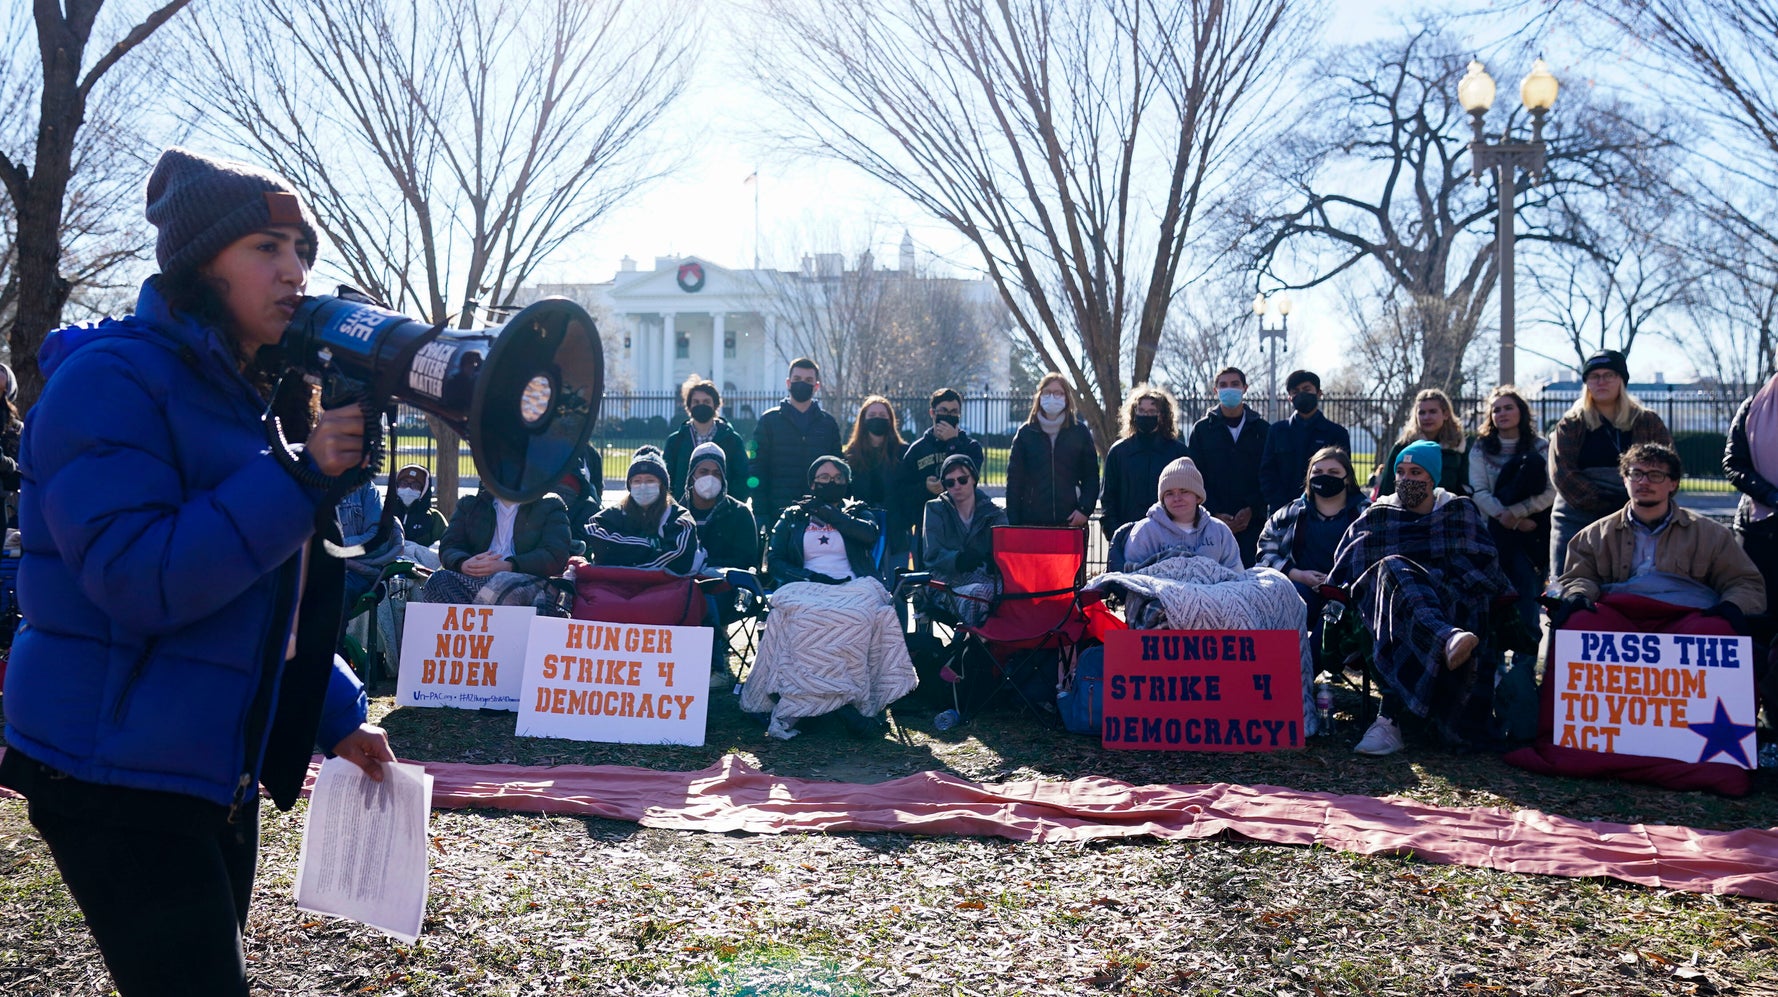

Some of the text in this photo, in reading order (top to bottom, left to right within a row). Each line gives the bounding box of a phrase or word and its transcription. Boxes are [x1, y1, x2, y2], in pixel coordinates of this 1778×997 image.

[411, 354, 448, 380] VOTERS
[409, 371, 443, 398] MATTER
[442, 607, 494, 633] ACT
[435, 634, 494, 659] NOW
[565, 623, 673, 654] HUNGER
[1141, 635, 1257, 662] HUNGER
[1581, 633, 1740, 669] PASS THE
[421, 659, 498, 686] BIDEN
[543, 654, 675, 687] STRIKE 4
[1567, 662, 1707, 699] FREEDOM
[1111, 674, 1273, 701] STRIKE 4
[535, 687, 695, 720] DEMOCRACY
[1561, 692, 1689, 729] TO VOTE
[1104, 716, 1298, 747] DEMOCRACY!
[1560, 724, 1621, 753] ACT
